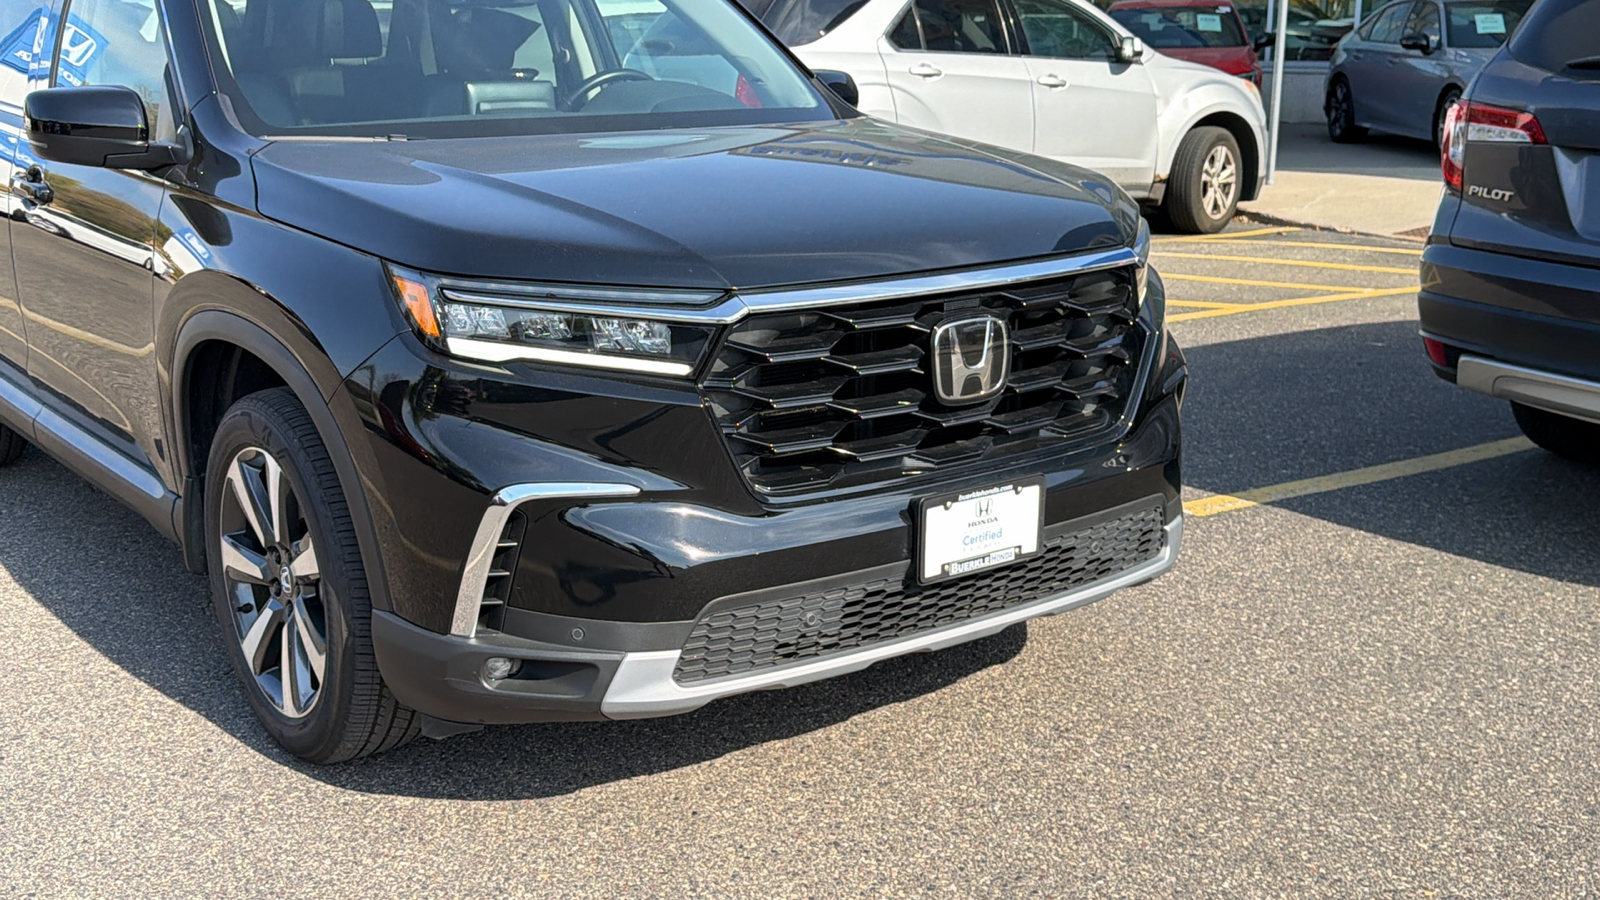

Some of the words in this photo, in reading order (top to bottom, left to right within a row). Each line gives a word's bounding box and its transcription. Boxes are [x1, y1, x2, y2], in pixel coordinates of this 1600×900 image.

[1468, 184, 1514, 202] PILOT
[968, 516, 998, 528] HONDA
[963, 527, 1003, 546] Certified
[951, 556, 990, 575] BUERKLE
